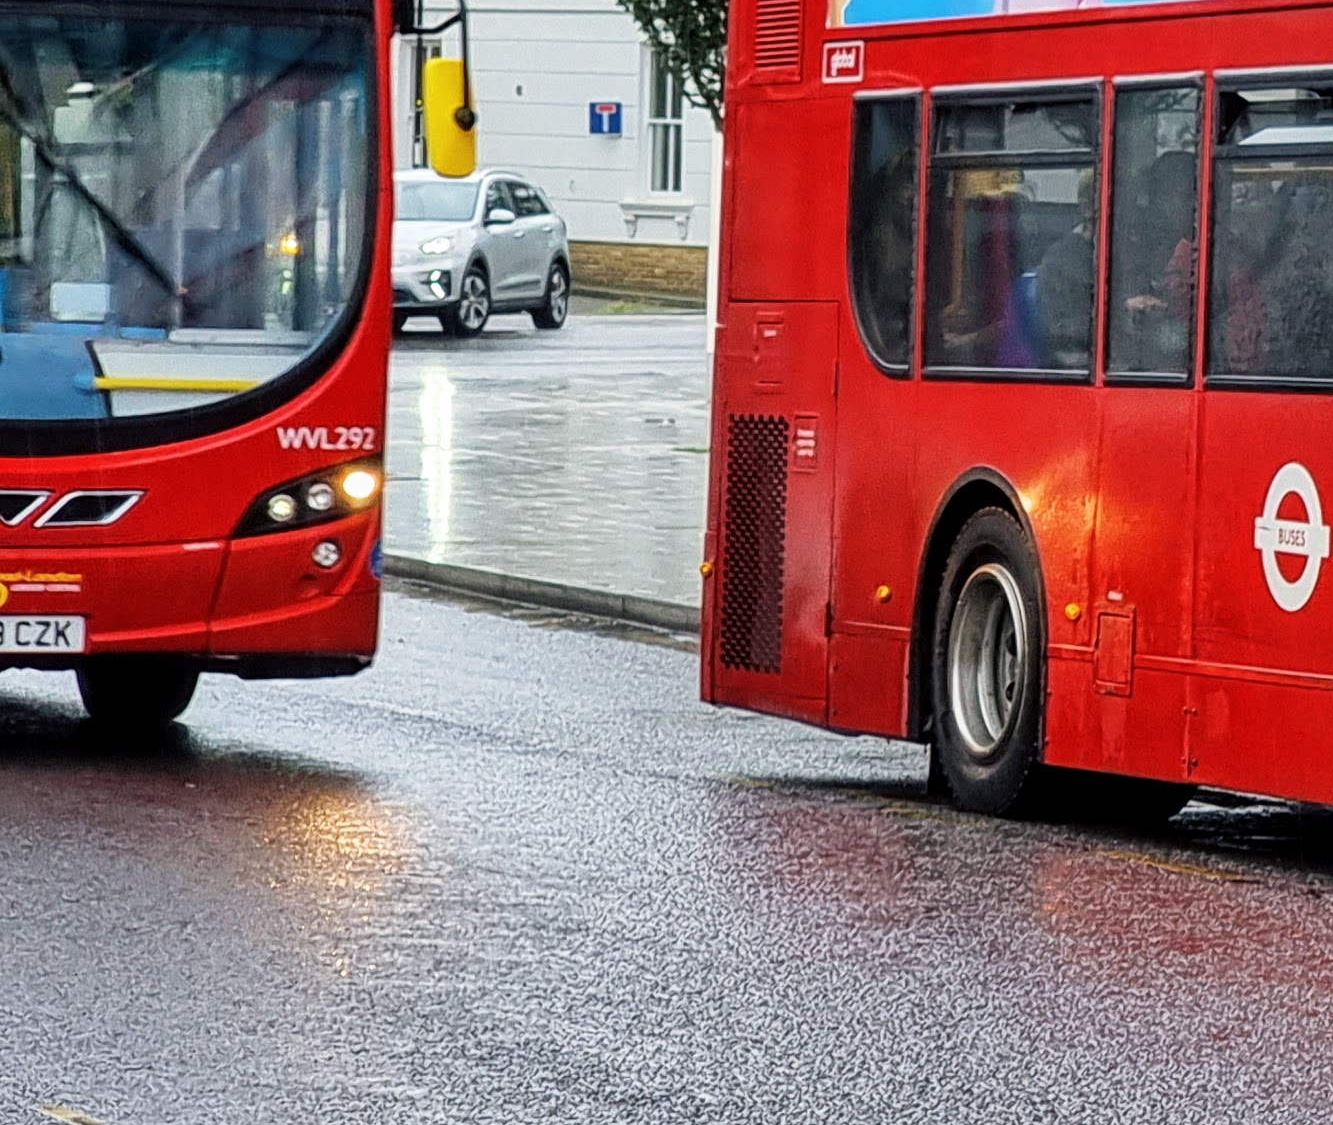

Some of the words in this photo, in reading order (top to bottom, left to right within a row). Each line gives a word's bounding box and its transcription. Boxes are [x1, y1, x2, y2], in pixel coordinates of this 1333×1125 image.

[276, 426, 376, 451] WVL292
[1278, 527, 1306, 547] BUSES
[15, 620, 72, 647] CZK
